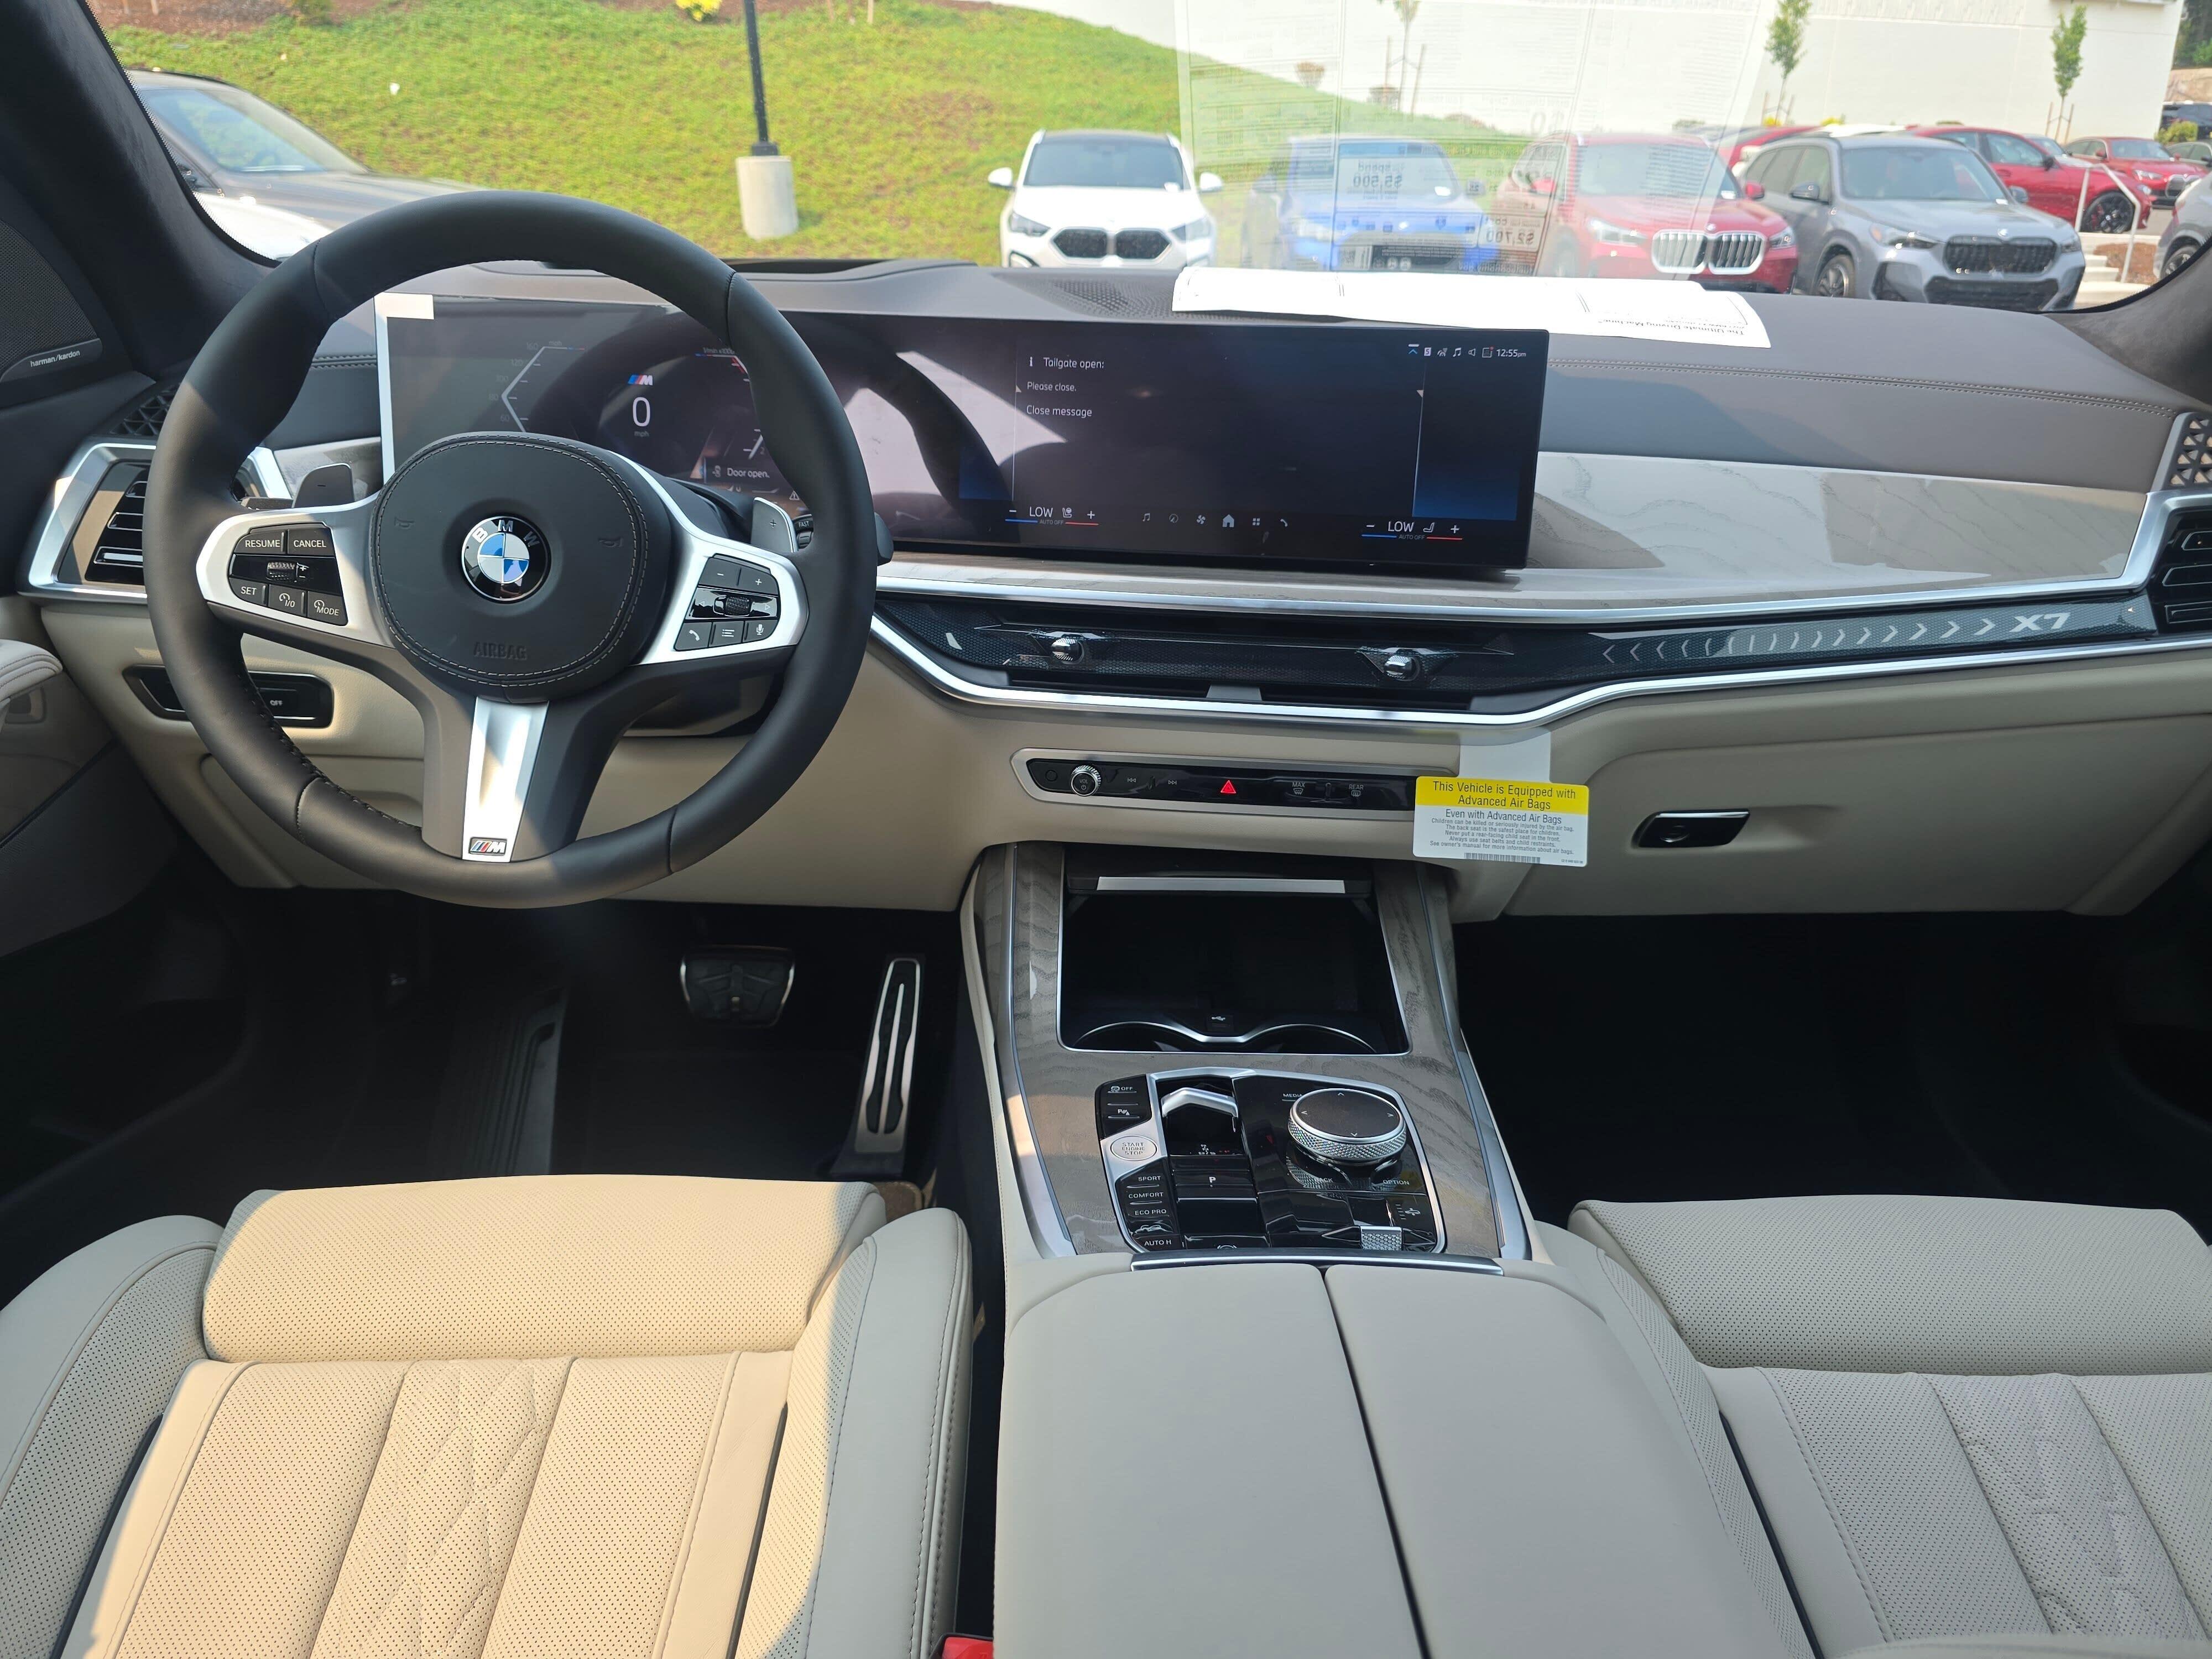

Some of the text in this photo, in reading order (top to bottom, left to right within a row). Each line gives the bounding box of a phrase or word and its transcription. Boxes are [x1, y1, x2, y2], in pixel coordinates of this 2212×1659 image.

[30, 350, 80, 367] harman/kardon
[1043, 357, 1077, 369] Tailgate
[1027, 382, 1077, 392] Please close.
[633, 397, 650, 427] 0
[1026, 405, 1092, 419] Close message
[727, 467, 770, 479] Door open.
[1029, 506, 1053, 518] LOW
[472, 519, 540, 547] BMW
[1387, 521, 1415, 532] LOW
[241, 586, 257, 595] SET
[316, 606, 339, 616] MODE
[2009, 612, 2072, 632] X7
[473, 641, 527, 660] AIRBAG
[1433, 781, 1575, 799] This Vehicle is Equipped with
[1458, 795, 1551, 811] Advanced Air Bags
[1446, 809, 1562, 825] Even with Advanced Air Bags
